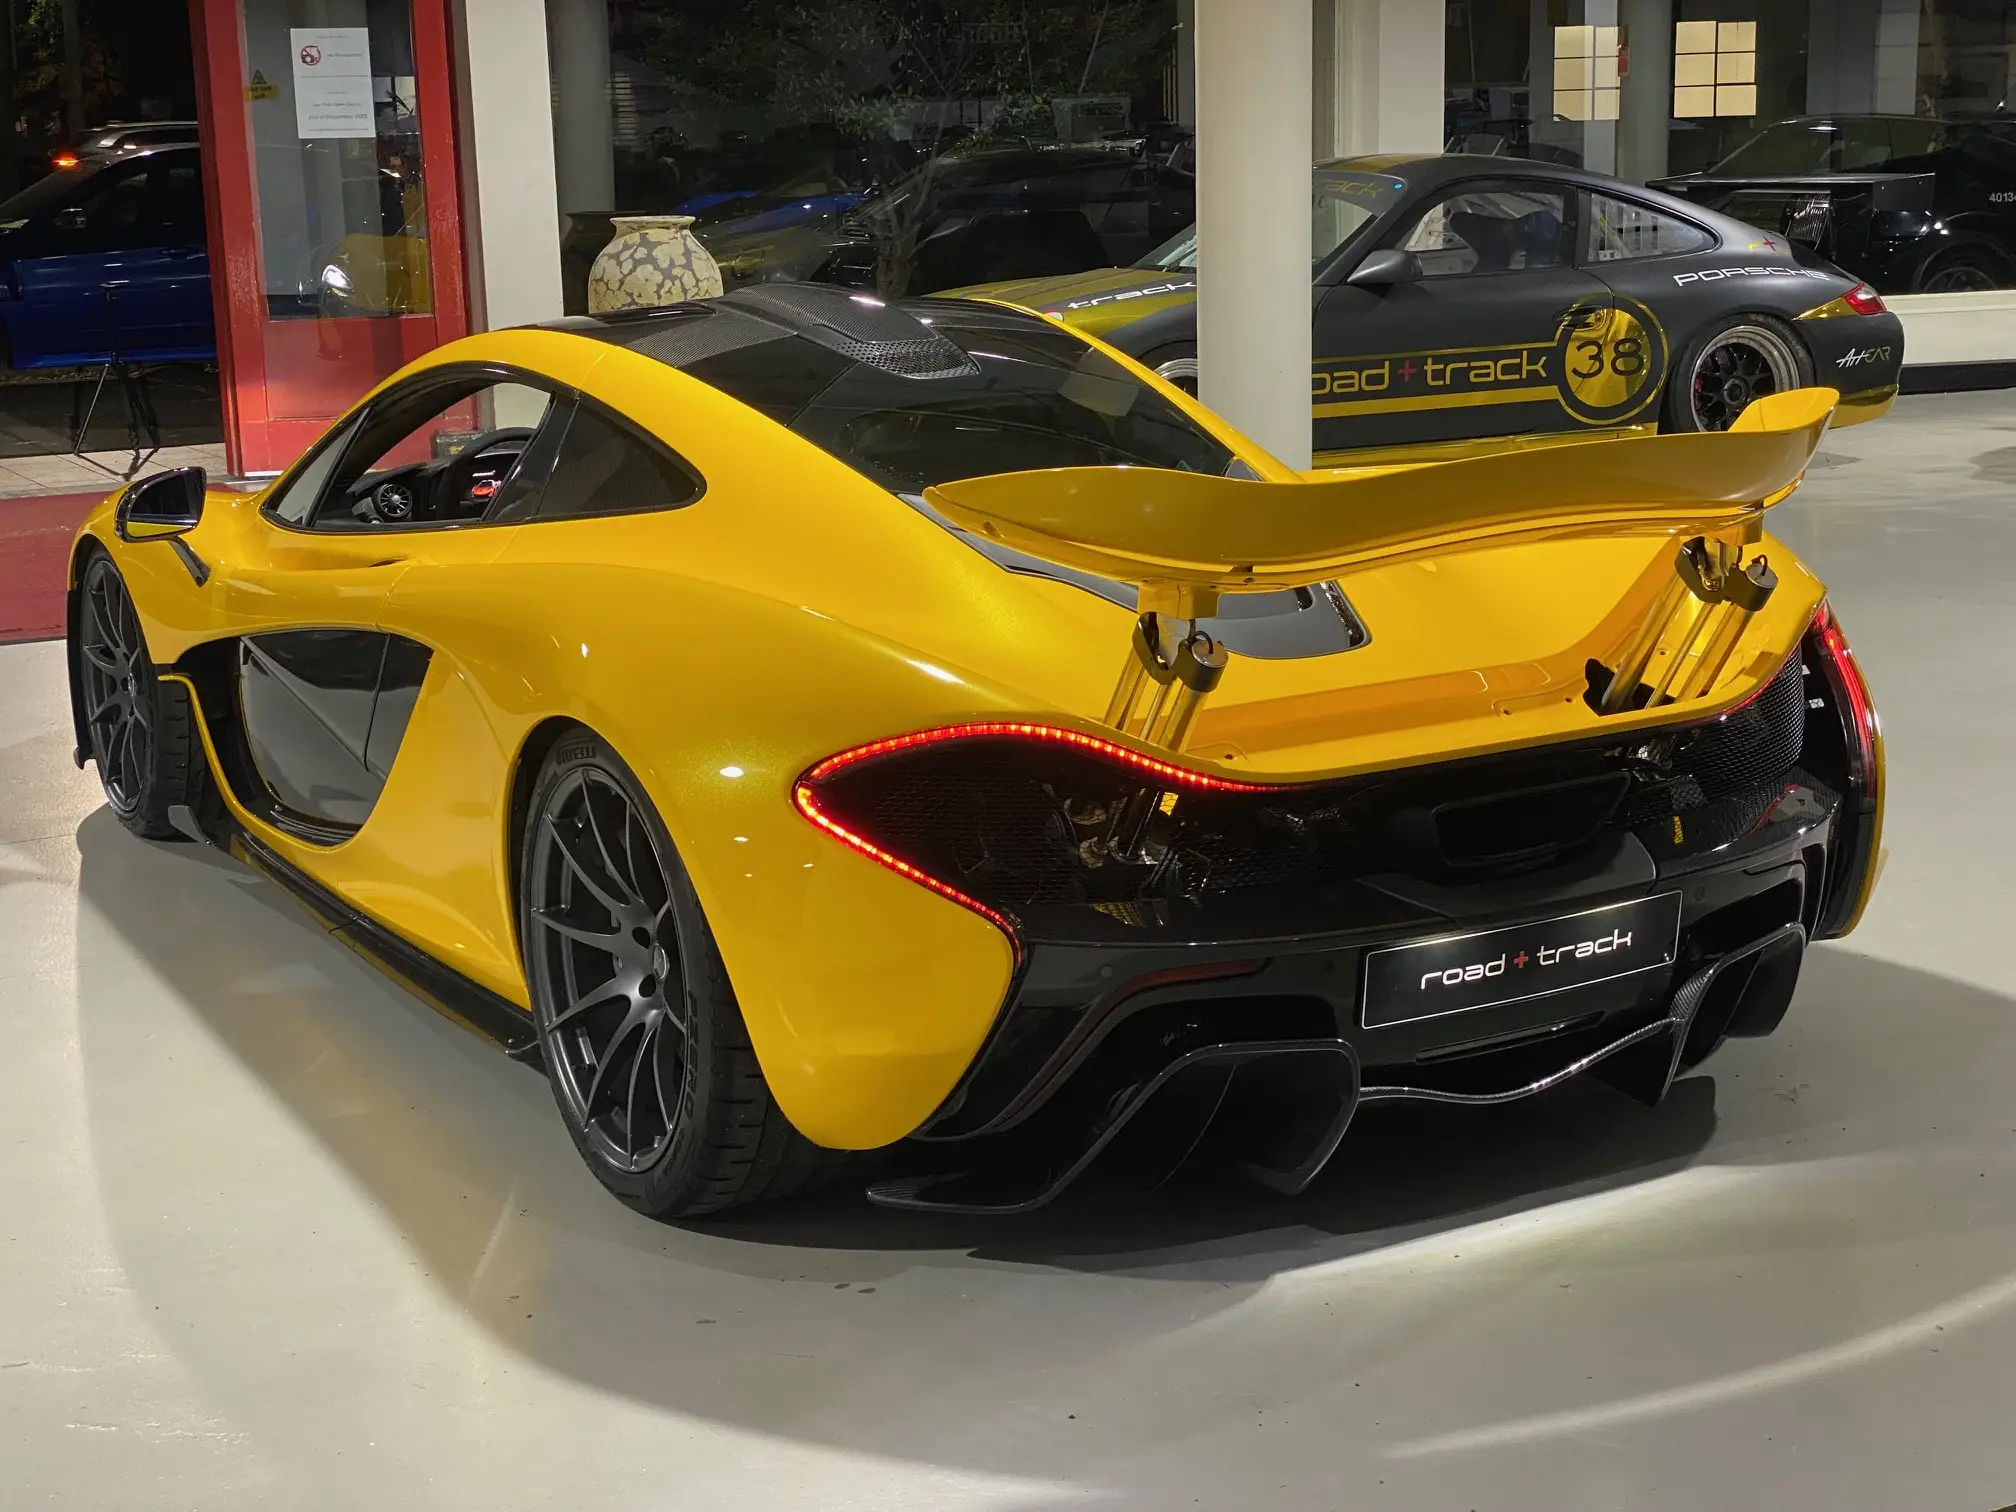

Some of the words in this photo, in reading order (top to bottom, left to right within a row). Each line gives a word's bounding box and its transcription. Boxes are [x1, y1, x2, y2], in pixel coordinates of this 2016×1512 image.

[1989, 191, 2016, 203] 4013
[1673, 266, 1831, 288] PORSCHE
[1067, 281, 1197, 309] track
[1312, 361, 1390, 395] oad
[1423, 350, 1548, 387] track
[1571, 337, 1646, 380] 38
[1420, 953, 1507, 990] road
[1536, 928, 1633, 967] track
